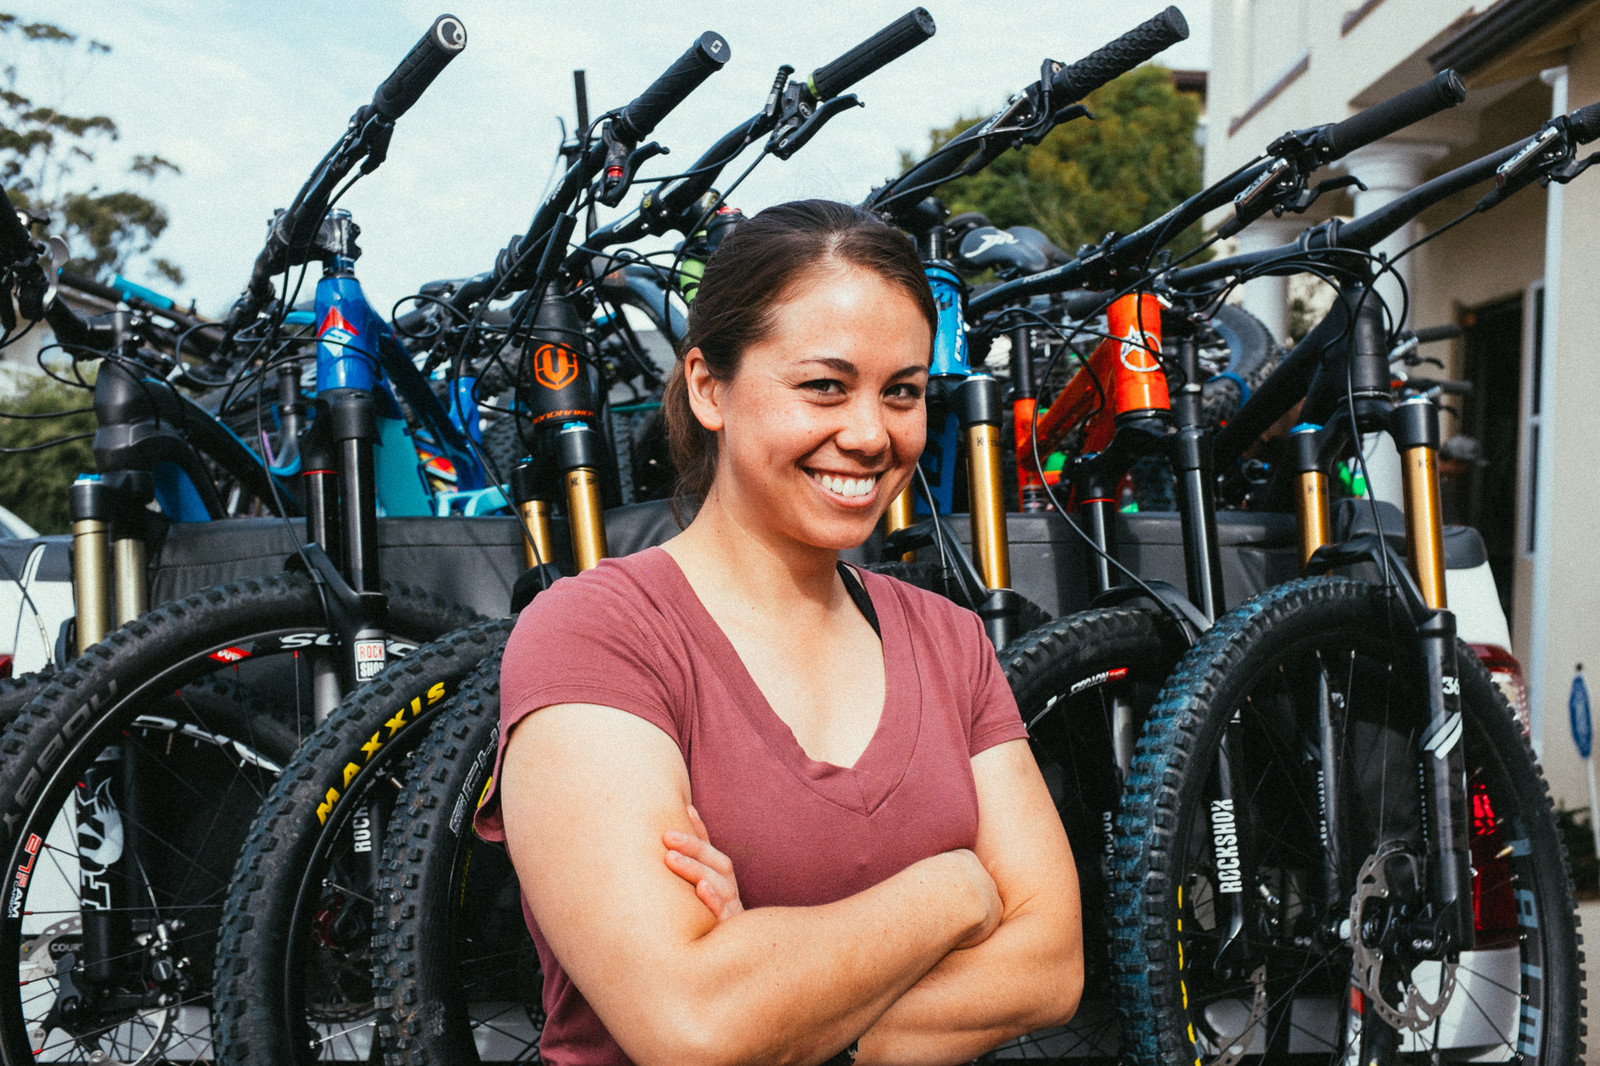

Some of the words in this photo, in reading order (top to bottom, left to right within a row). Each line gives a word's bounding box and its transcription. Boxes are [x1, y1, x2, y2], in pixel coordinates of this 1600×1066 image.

[360, 645, 384, 659] ROCK
[315, 681, 446, 827] MAXXIS
[1210, 798, 1243, 893] ROCKSHOX
